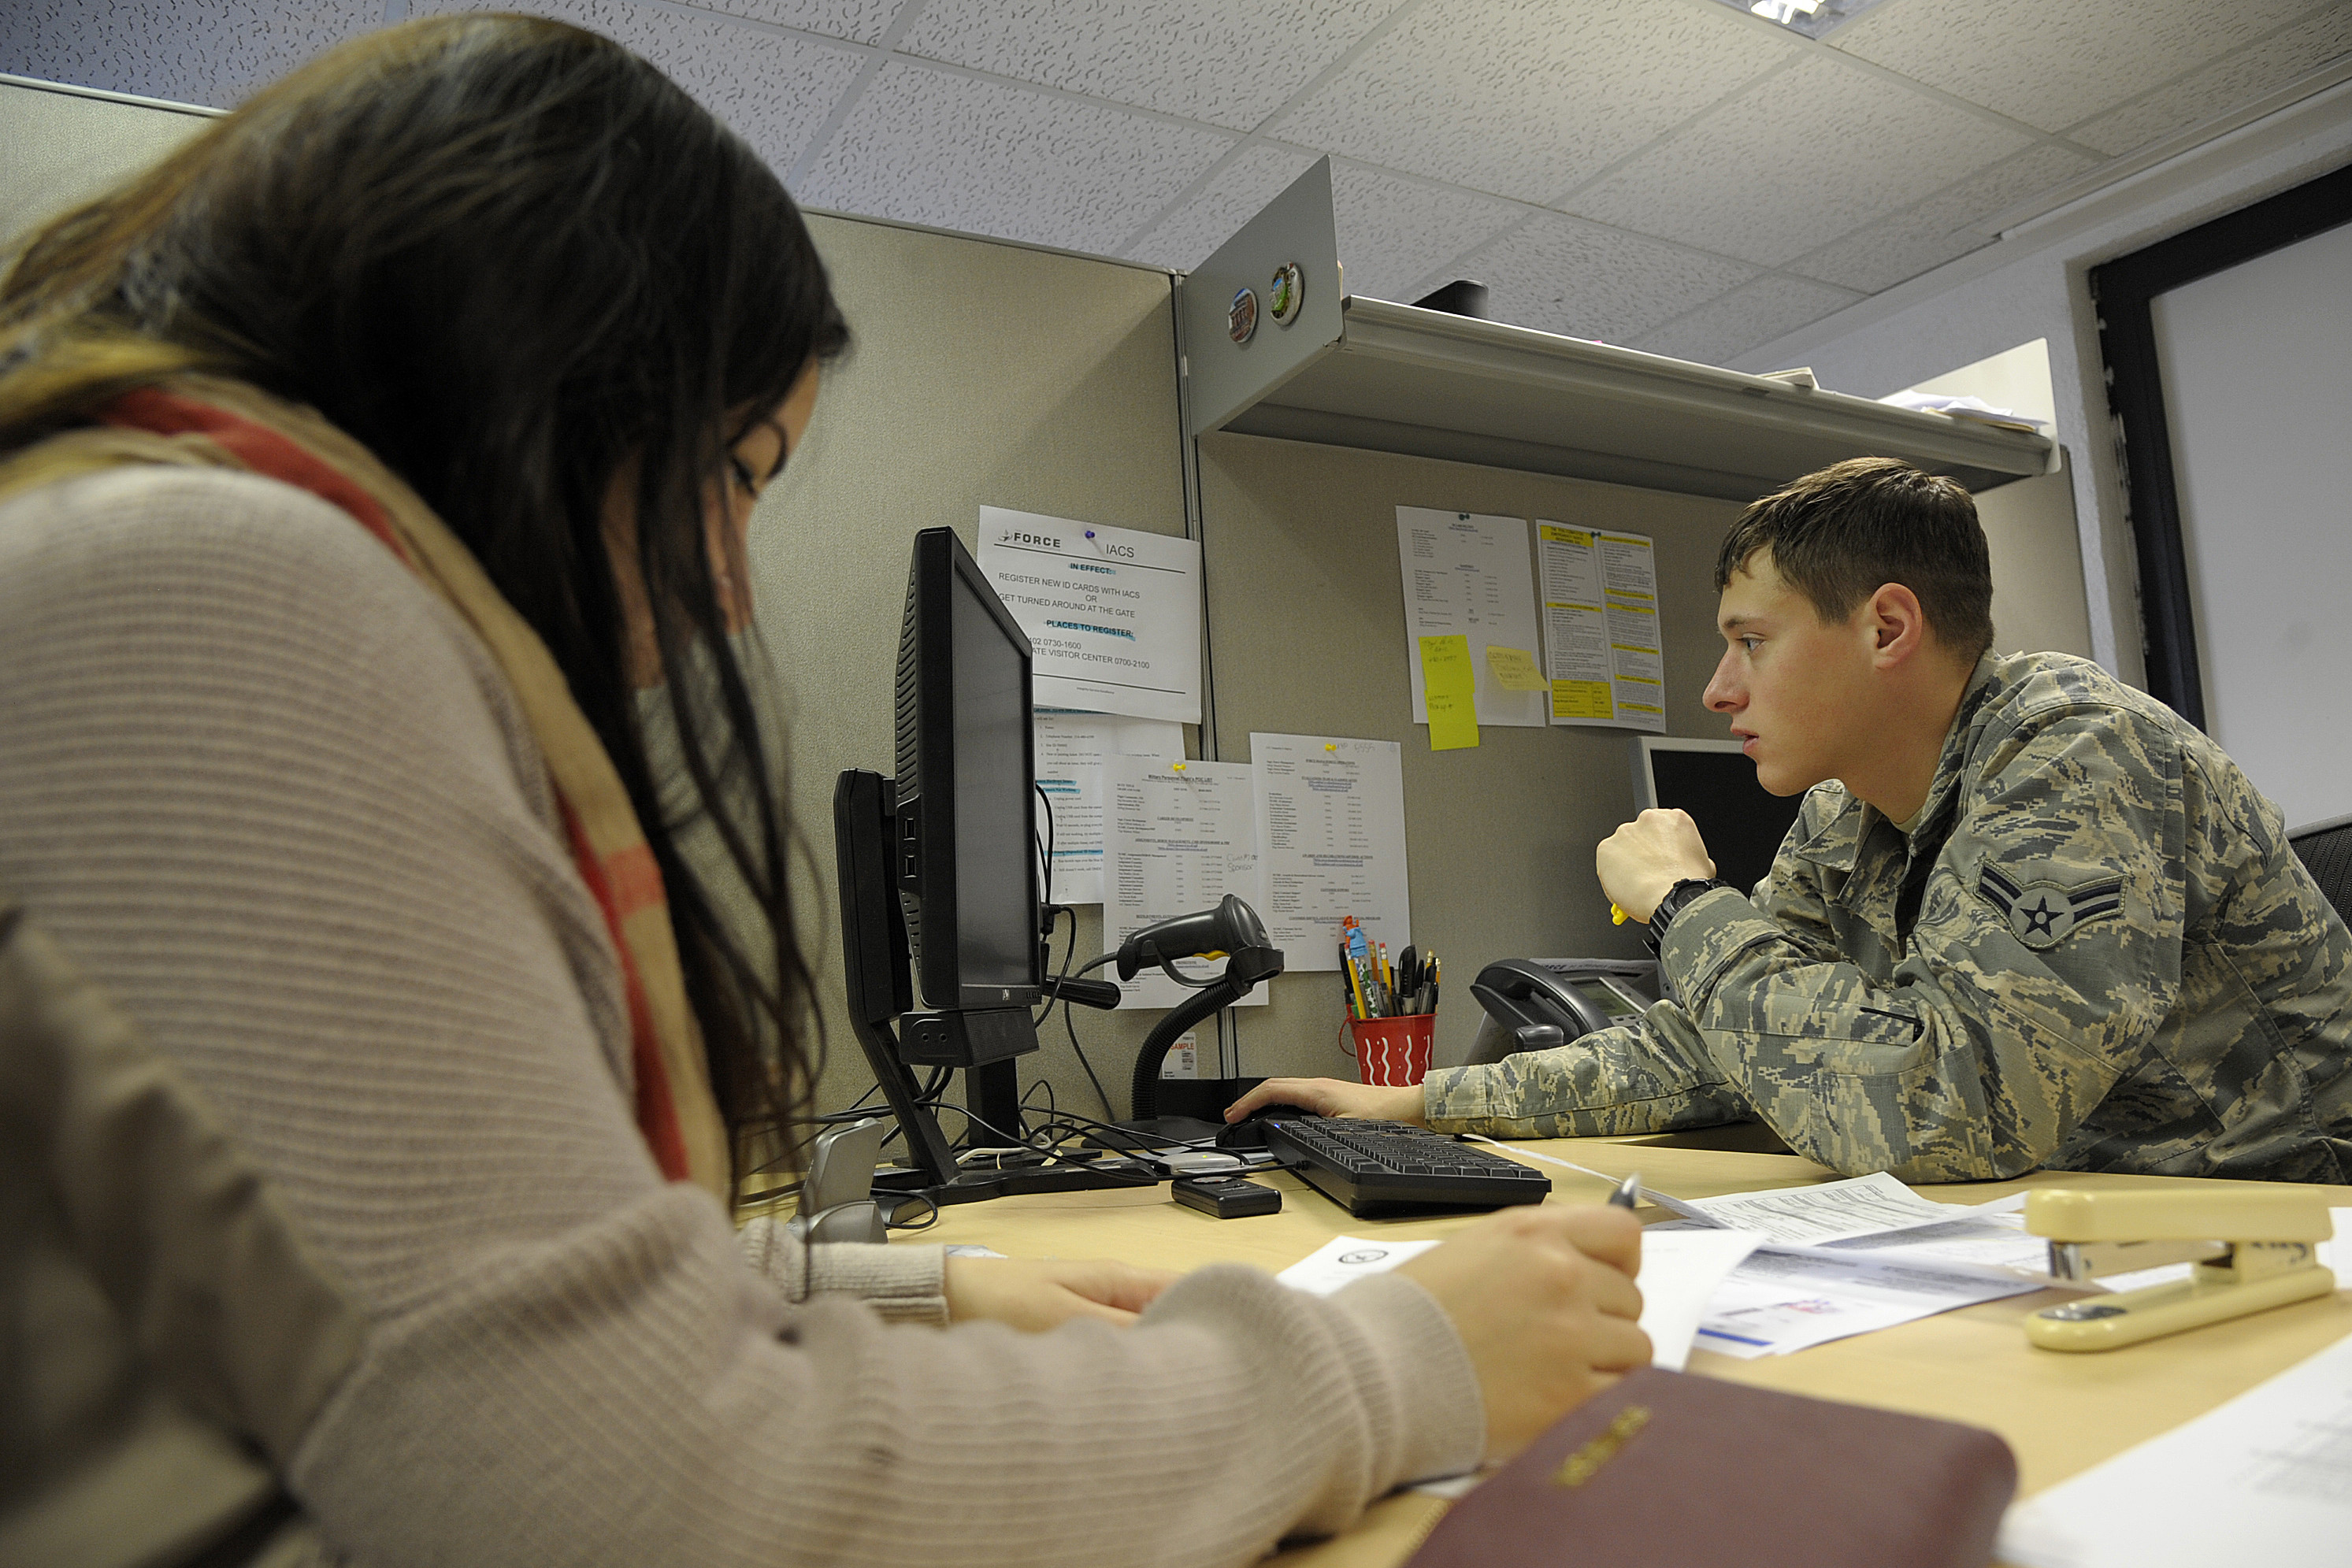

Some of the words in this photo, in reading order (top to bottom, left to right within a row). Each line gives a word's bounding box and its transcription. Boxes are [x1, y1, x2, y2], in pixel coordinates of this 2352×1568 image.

[1014, 532, 1060, 547] FORCE
[1106, 543, 1134, 558] IACS
[999, 572, 1040, 585] REGISTER
[1042, 577, 1060, 588] NEW
[1063, 580, 1071, 589] ID
[1072, 583, 1100, 594] CARDS
[1101, 587, 1120, 597] WITH
[1122, 590, 1141, 599] IACS
[1017, 595, 1050, 606] TURNED
[1052, 600, 1085, 611] AROUND
[1098, 606, 1114, 615] THE
[1115, 609, 1135, 618] GATE
[1046, 620, 1078, 630] PLACES
[1093, 625, 1134, 638] REGISTER:
[1043, 638, 1081, 650] 0730-1600
[1048, 649, 1080, 660] VISITOR
[1081, 653, 1113, 664] CENTER
[1115, 658, 1150, 669] 0700-2100
